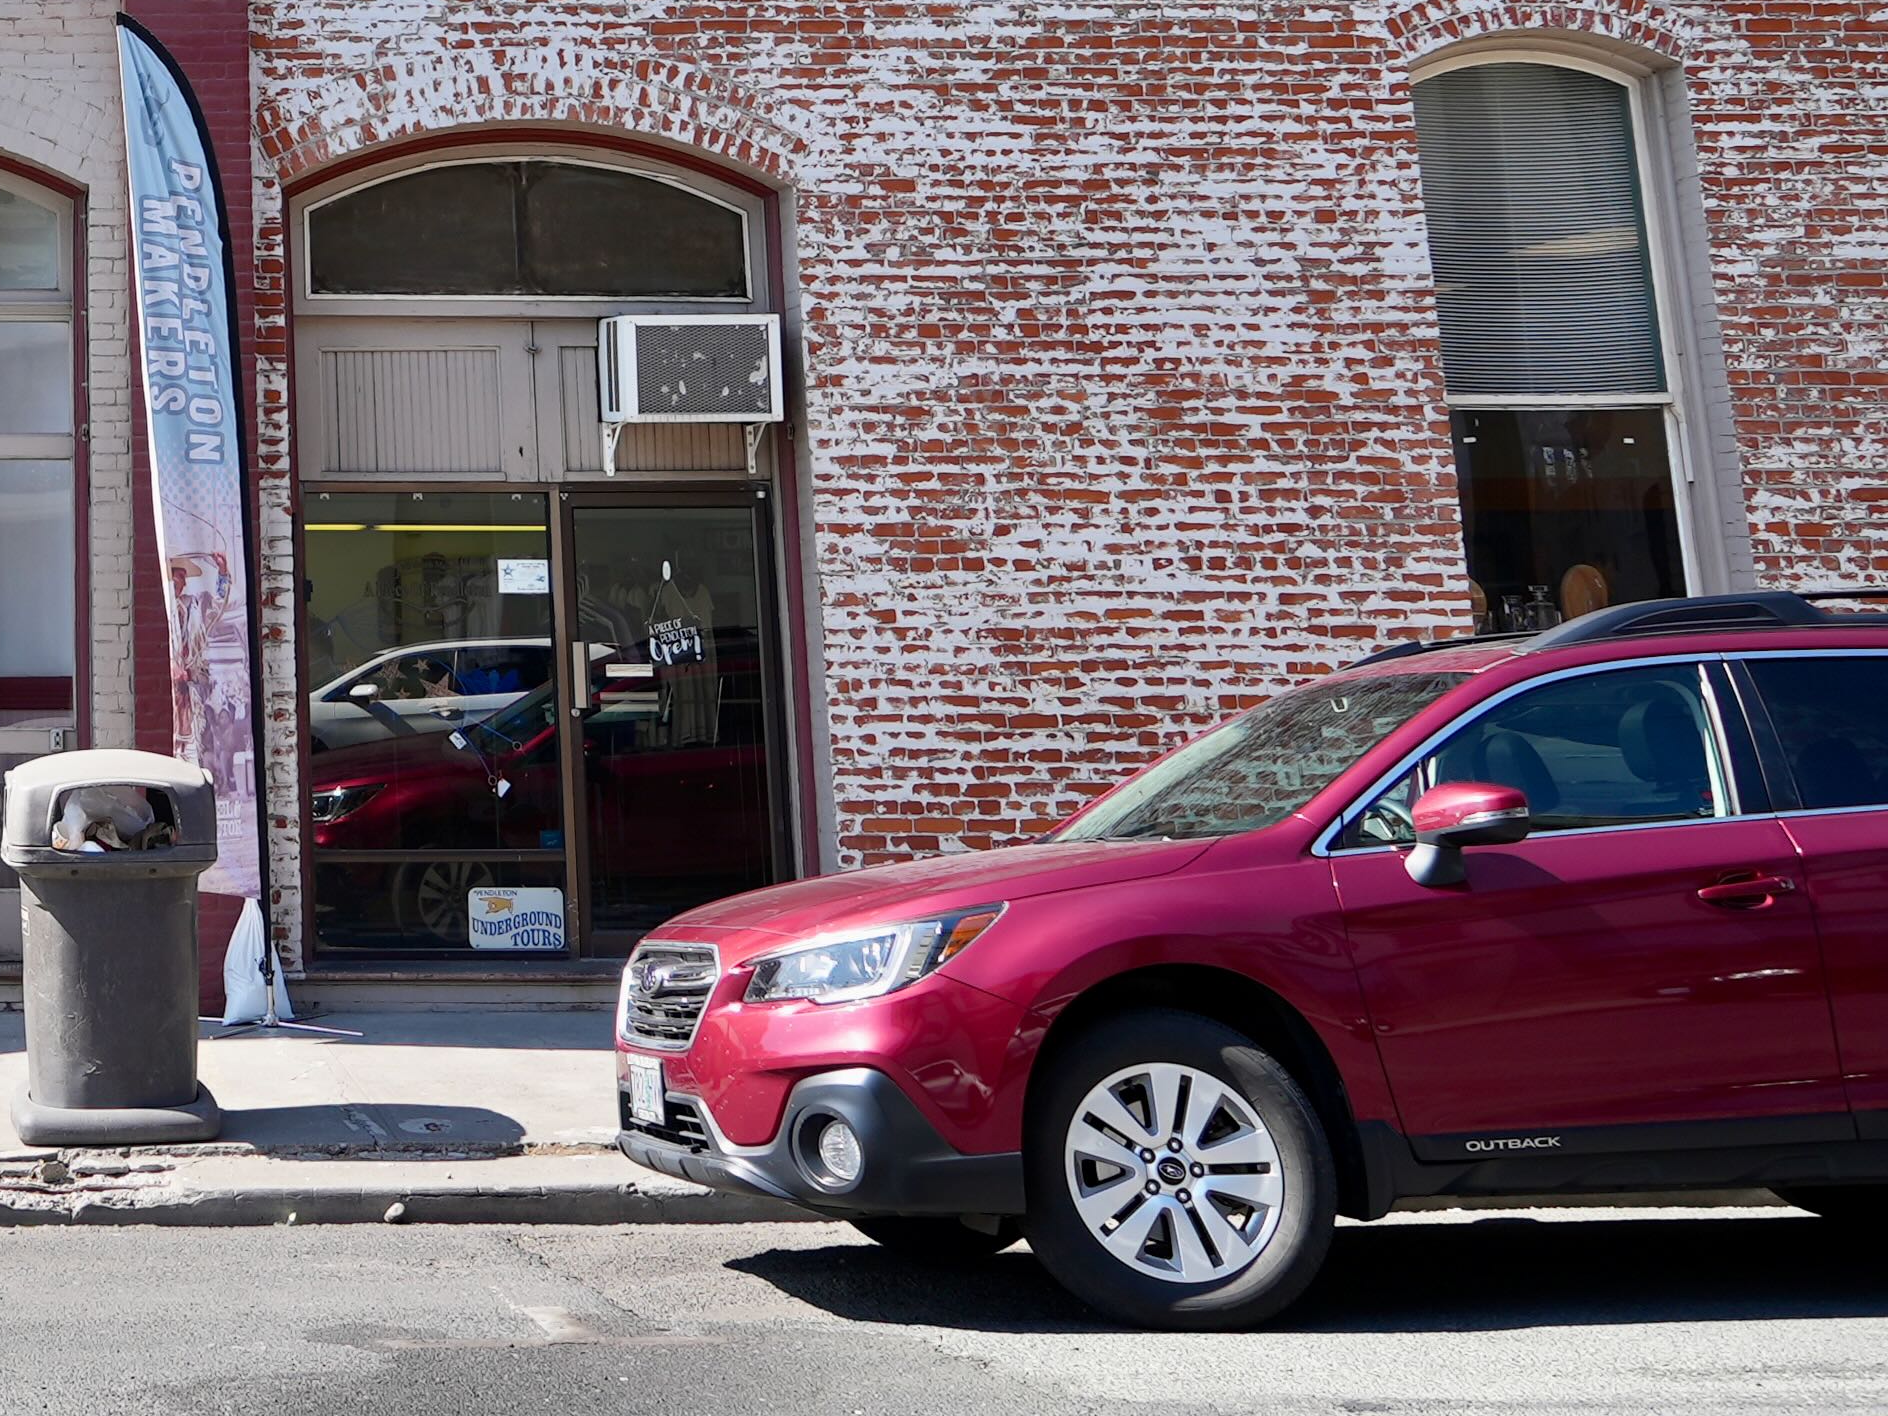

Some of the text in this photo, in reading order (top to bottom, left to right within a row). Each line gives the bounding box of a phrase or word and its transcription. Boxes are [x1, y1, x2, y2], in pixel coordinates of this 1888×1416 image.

[139, 196, 189, 415] MAKERS
[168, 156, 225, 465] PENDLETON
[649, 618, 682, 635] A PIECE OF
[659, 626, 697, 643] PENDLETON
[472, 911, 562, 936] UNDERGROUND
[511, 928, 562, 947] TOURS
[1465, 1136, 1561, 1152] OUTBACK
